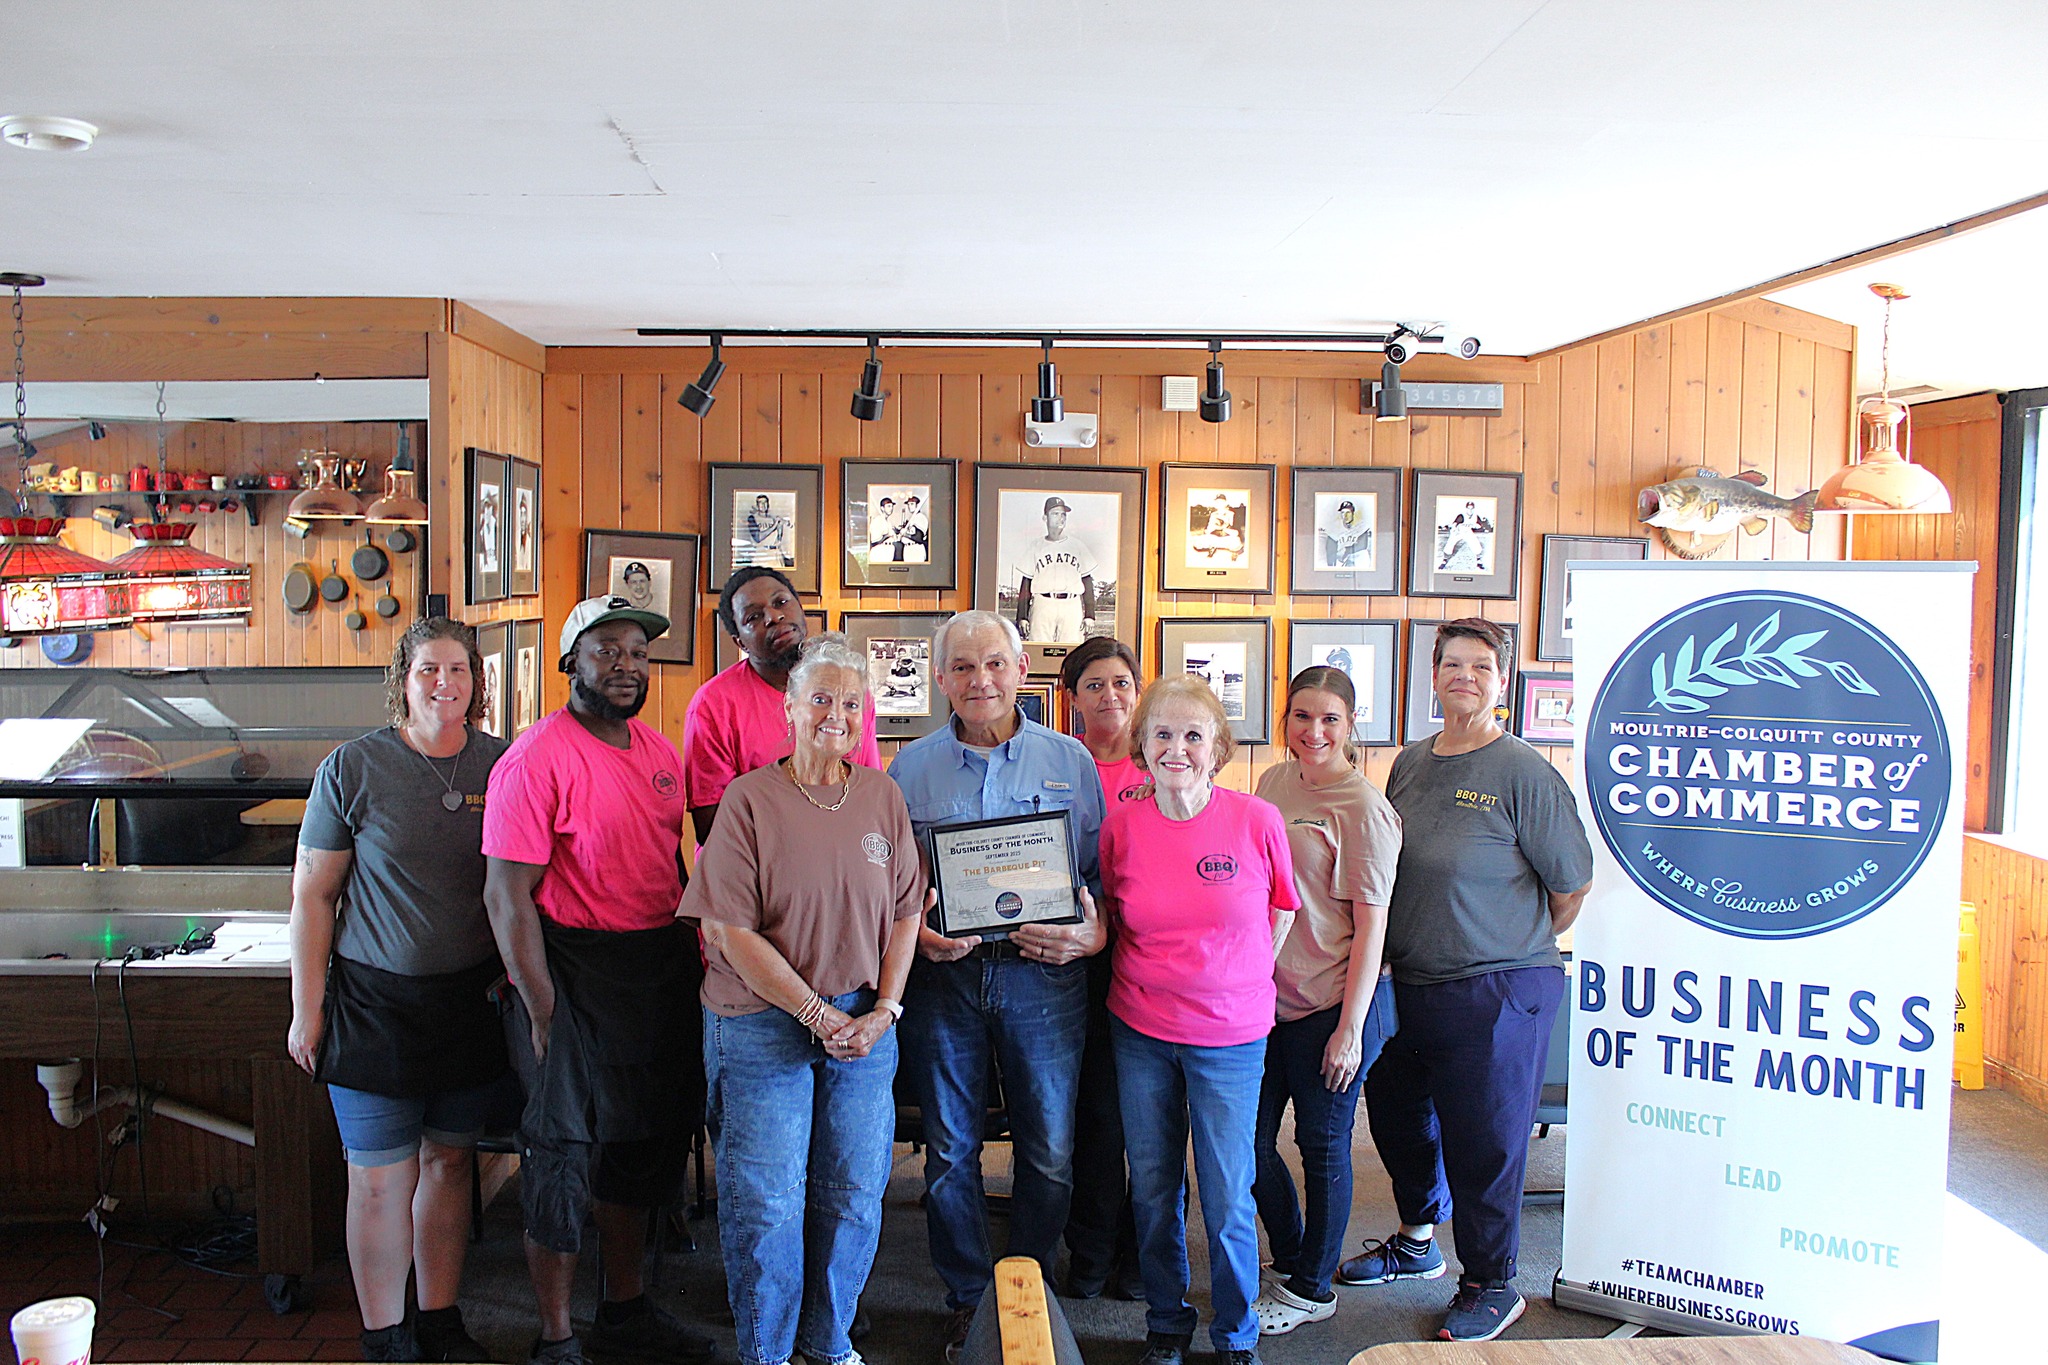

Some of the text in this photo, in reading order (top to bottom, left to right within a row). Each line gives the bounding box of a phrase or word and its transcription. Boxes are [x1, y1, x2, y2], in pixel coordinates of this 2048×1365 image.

[1610, 722, 1922, 749] MOULTRIE-COLQUITT COUNTY
[1608, 744, 1929, 792] CHAMBER of
[1455, 789, 1498, 806] BBQ PIT
[1608, 782, 1920, 834] COMMERCE
[869, 840, 888, 855] BBQ
[1005, 840, 1021, 848] THE
[1024, 836, 1054, 846] MONTH
[963, 868, 981, 876] THE
[1032, 860, 1046, 868] PIT
[1204, 862, 1233, 872] BBQ
[1641, 841, 1879, 914] WHERE business GROWS
[1579, 960, 1935, 1052] BUSINESS
[1587, 1028, 1925, 1110] OF THE MONTH
[1626, 1102, 1726, 1138] CONNECT
[1724, 1164, 1782, 1192] LEAD
[1780, 1227, 1900, 1269] PROMOTE
[1621, 1258, 1764, 1300] #TEAMCHAMBER
[1588, 1280, 1800, 1336] #WHEREBUSINESSGROWS
